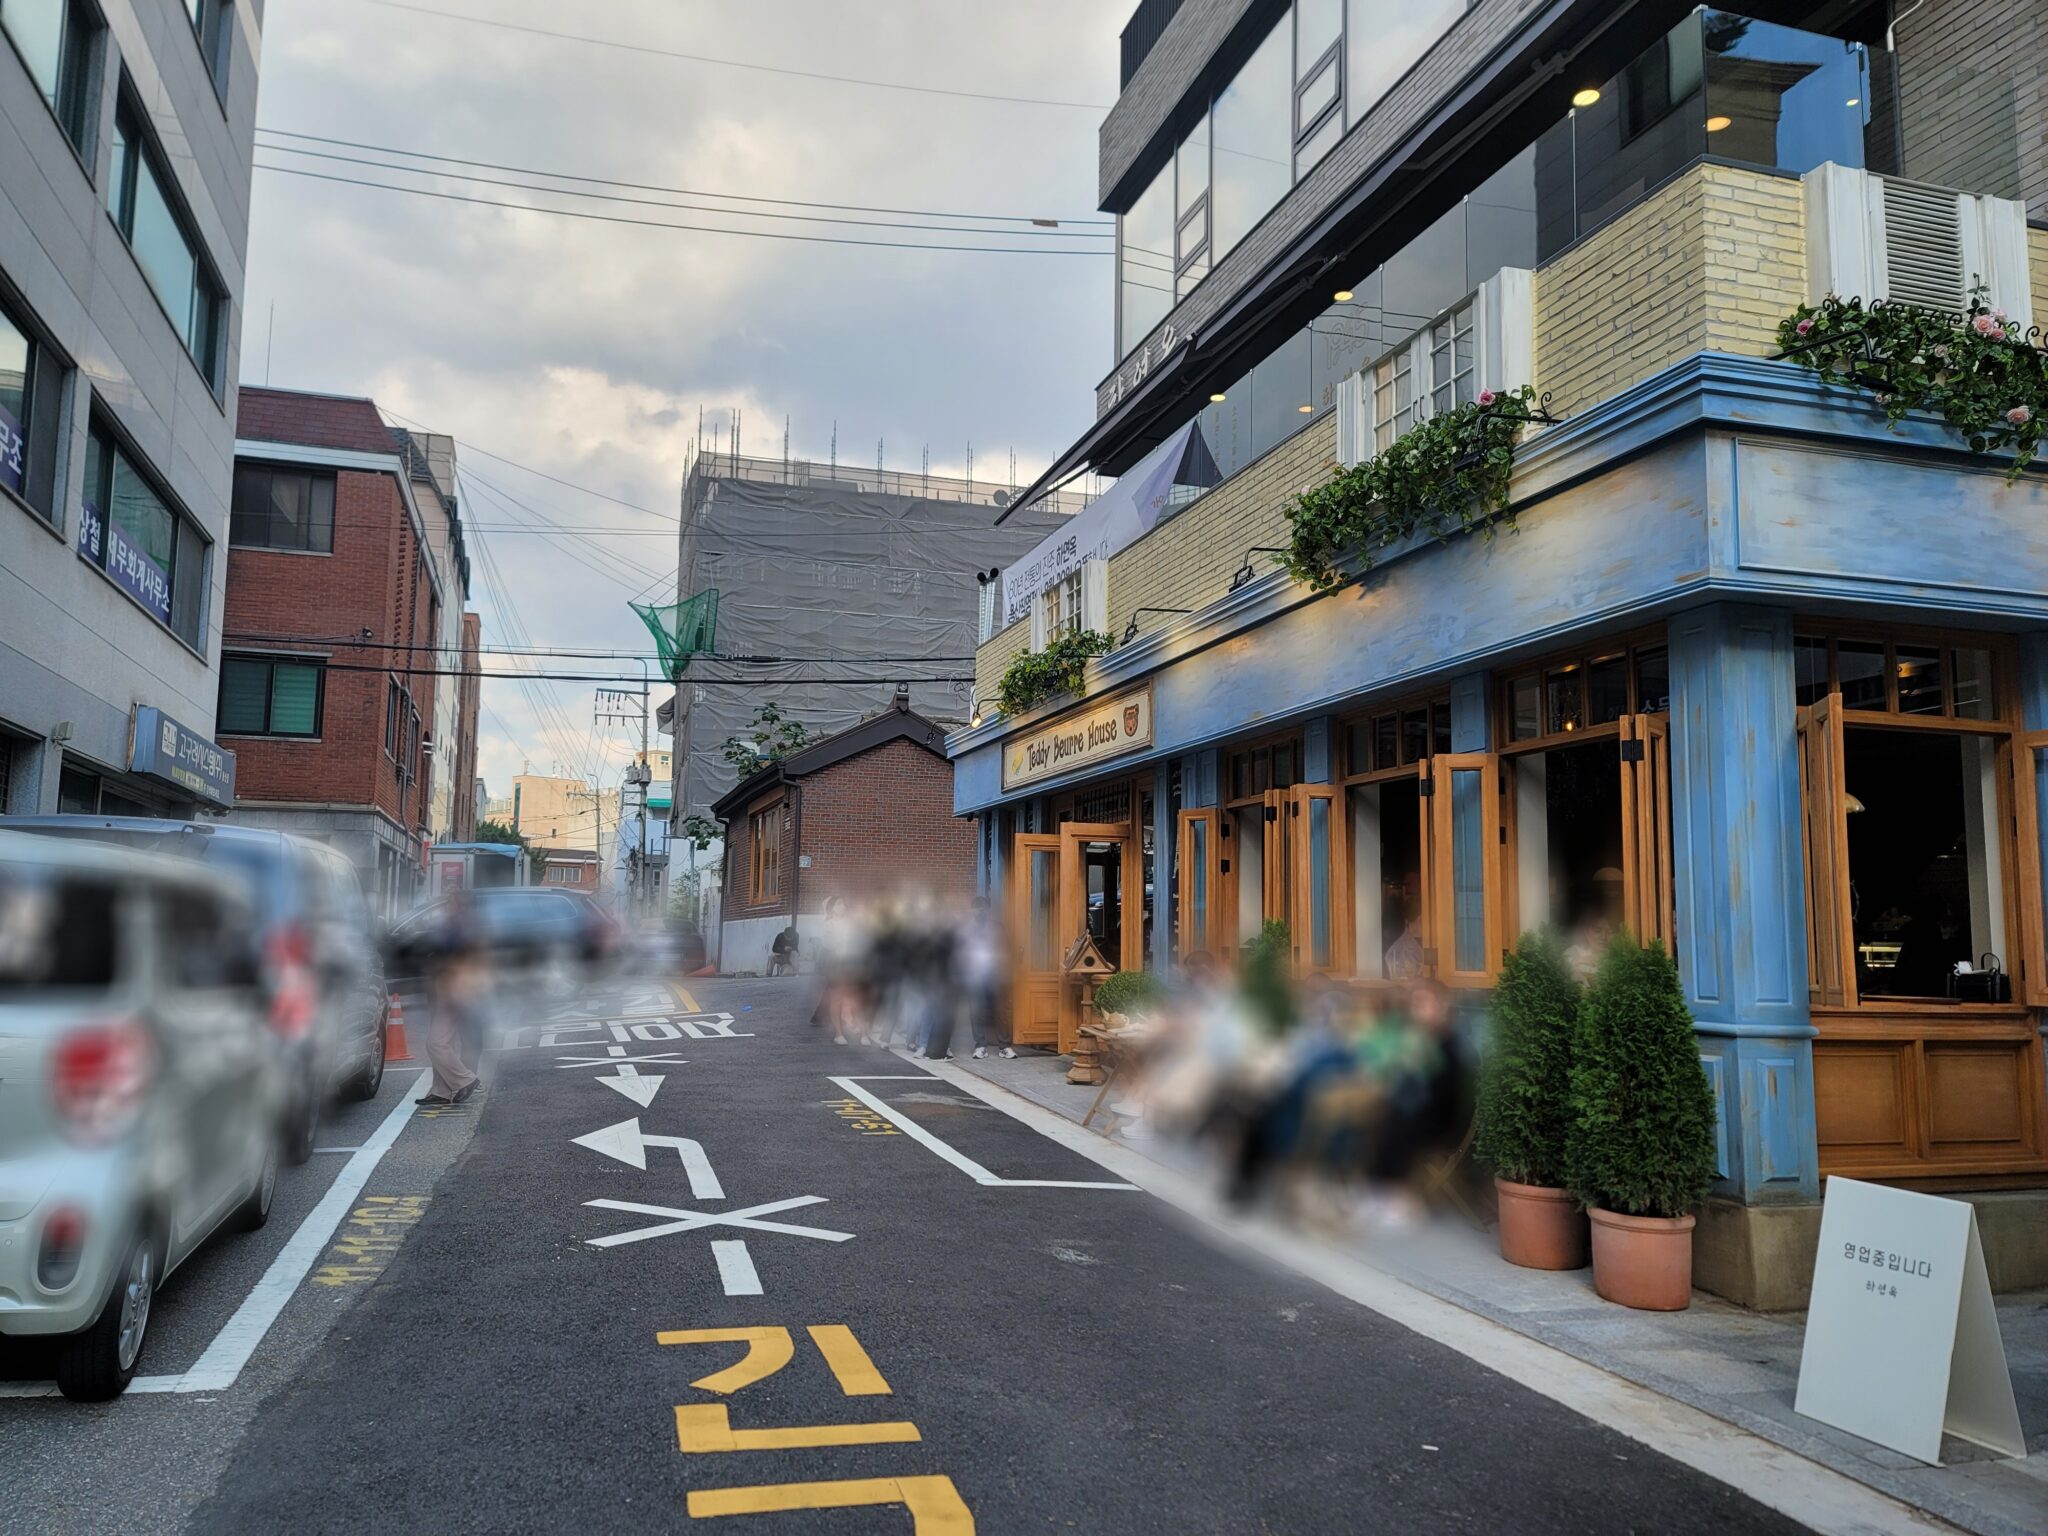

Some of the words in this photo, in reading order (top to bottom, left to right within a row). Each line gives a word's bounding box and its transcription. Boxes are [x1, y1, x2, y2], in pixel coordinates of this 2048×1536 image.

[1056, 535, 1078, 566] 하연옥
[108, 530, 170, 613] 세무회계사무소
[1026, 740, 1051, 771] Teddy
[1053, 731, 1084, 763] Beurre
[1087, 718, 1118, 751] House
[1843, 1241, 1933, 1279] 영업중입니다
[1865, 1279, 1898, 1298] 하연옥
